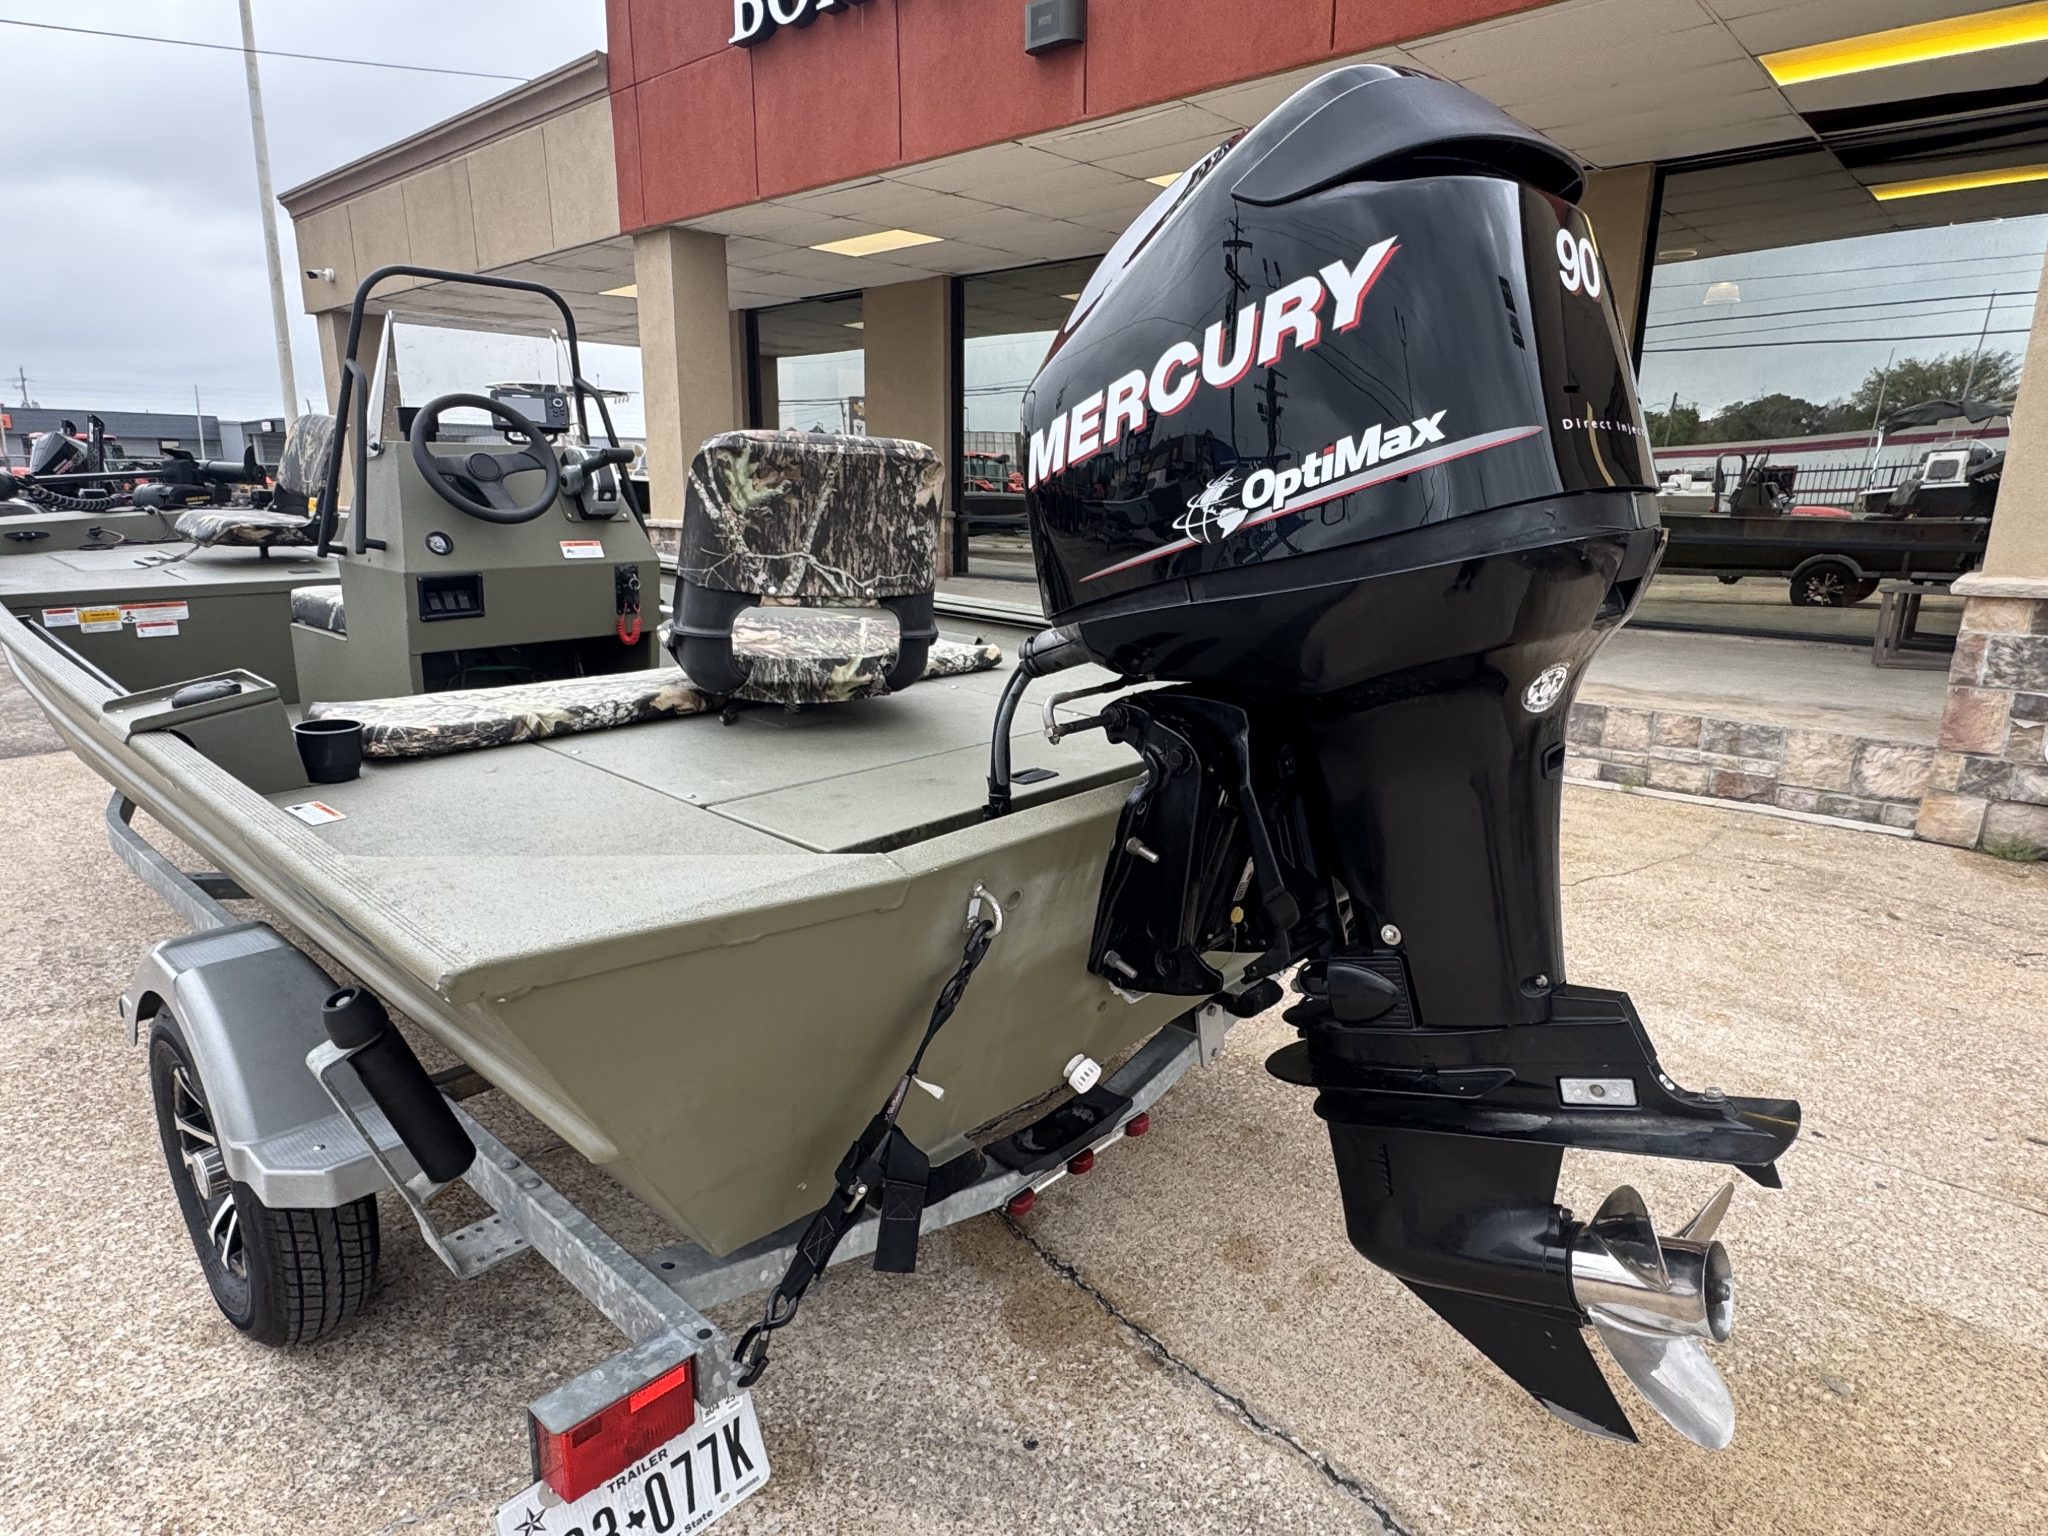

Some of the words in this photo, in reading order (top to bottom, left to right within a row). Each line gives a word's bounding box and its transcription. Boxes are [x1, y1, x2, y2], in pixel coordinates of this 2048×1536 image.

[1556, 228, 1601, 298] 90
[1028, 234, 1401, 490] MERCURY
[1562, 418, 1612, 430] Direct
[1241, 409, 1447, 511] OptiMax
[606, 1448, 669, 1494] TRAILER
[684, 1509, 713, 1534] State
